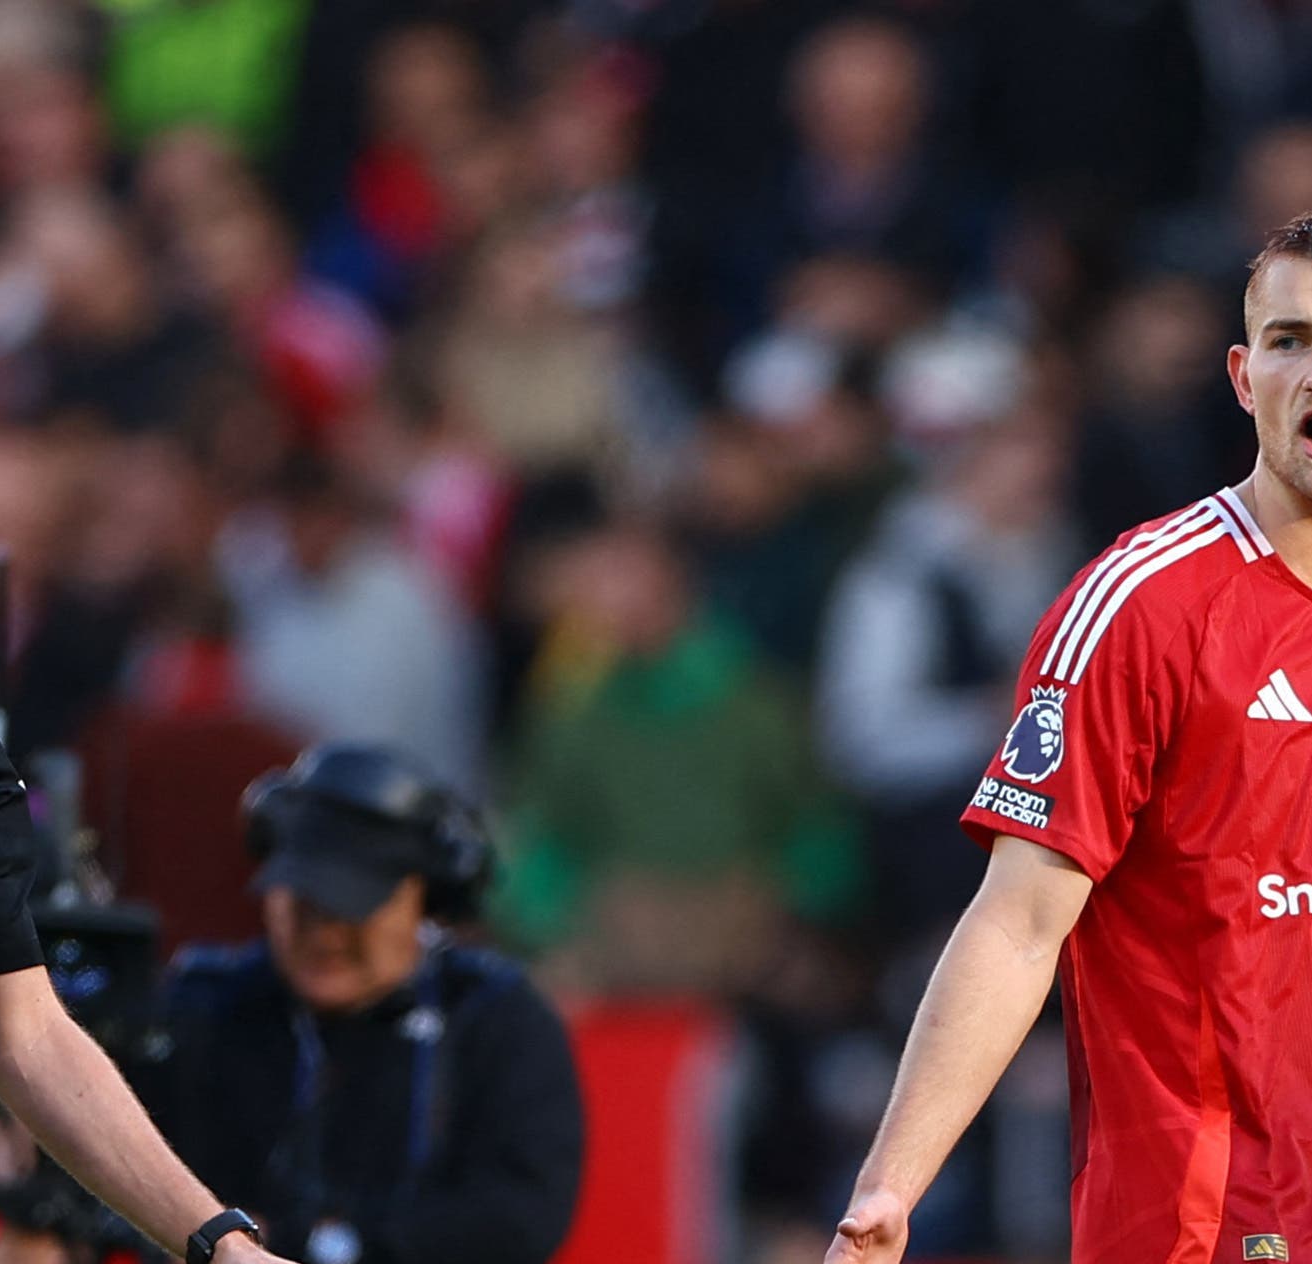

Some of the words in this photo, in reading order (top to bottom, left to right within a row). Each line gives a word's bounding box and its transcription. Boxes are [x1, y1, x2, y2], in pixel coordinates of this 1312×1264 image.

[978, 776, 999, 795] No
[999, 784, 1047, 813] room
[991, 798, 1048, 829] racism
